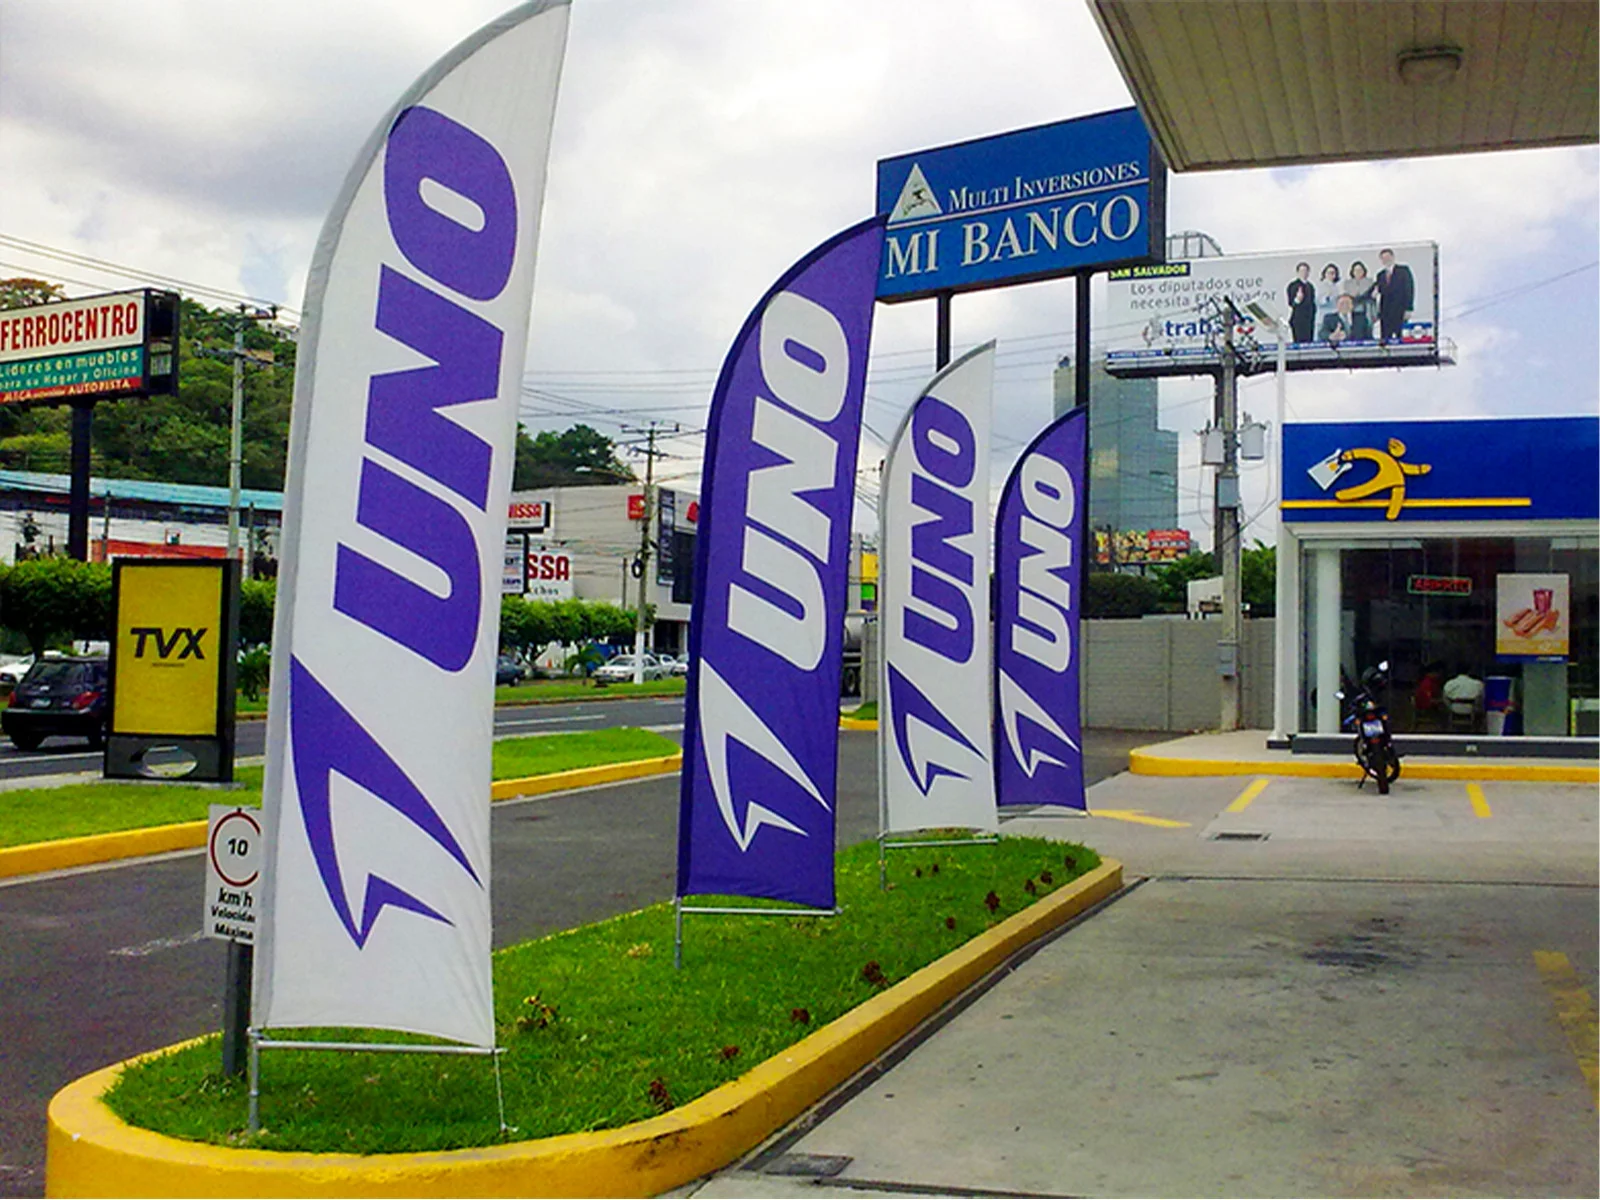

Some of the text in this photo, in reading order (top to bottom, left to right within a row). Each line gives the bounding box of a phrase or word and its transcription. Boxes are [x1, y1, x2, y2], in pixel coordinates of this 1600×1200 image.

[884, 194, 1140, 279] MI BANCO
[1131, 275, 1263, 295] Los diputados que
[1133, 264, 1187, 276] SALVADOR
[1130, 297, 1189, 309] necesita
[1212, 289, 1277, 305] Slvador
[1, 302, 138, 351] FERROCENTRO
[55, 358, 72, 370] en
[75, 350, 139, 367] muebles
[333, 105, 518, 672] UNO
[727, 290, 849, 671] UNO
[903, 395, 976, 664] UNO
[1012, 453, 1074, 672] UNO
[130, 627, 208, 661] TVX
[228, 838, 248, 856] 10
